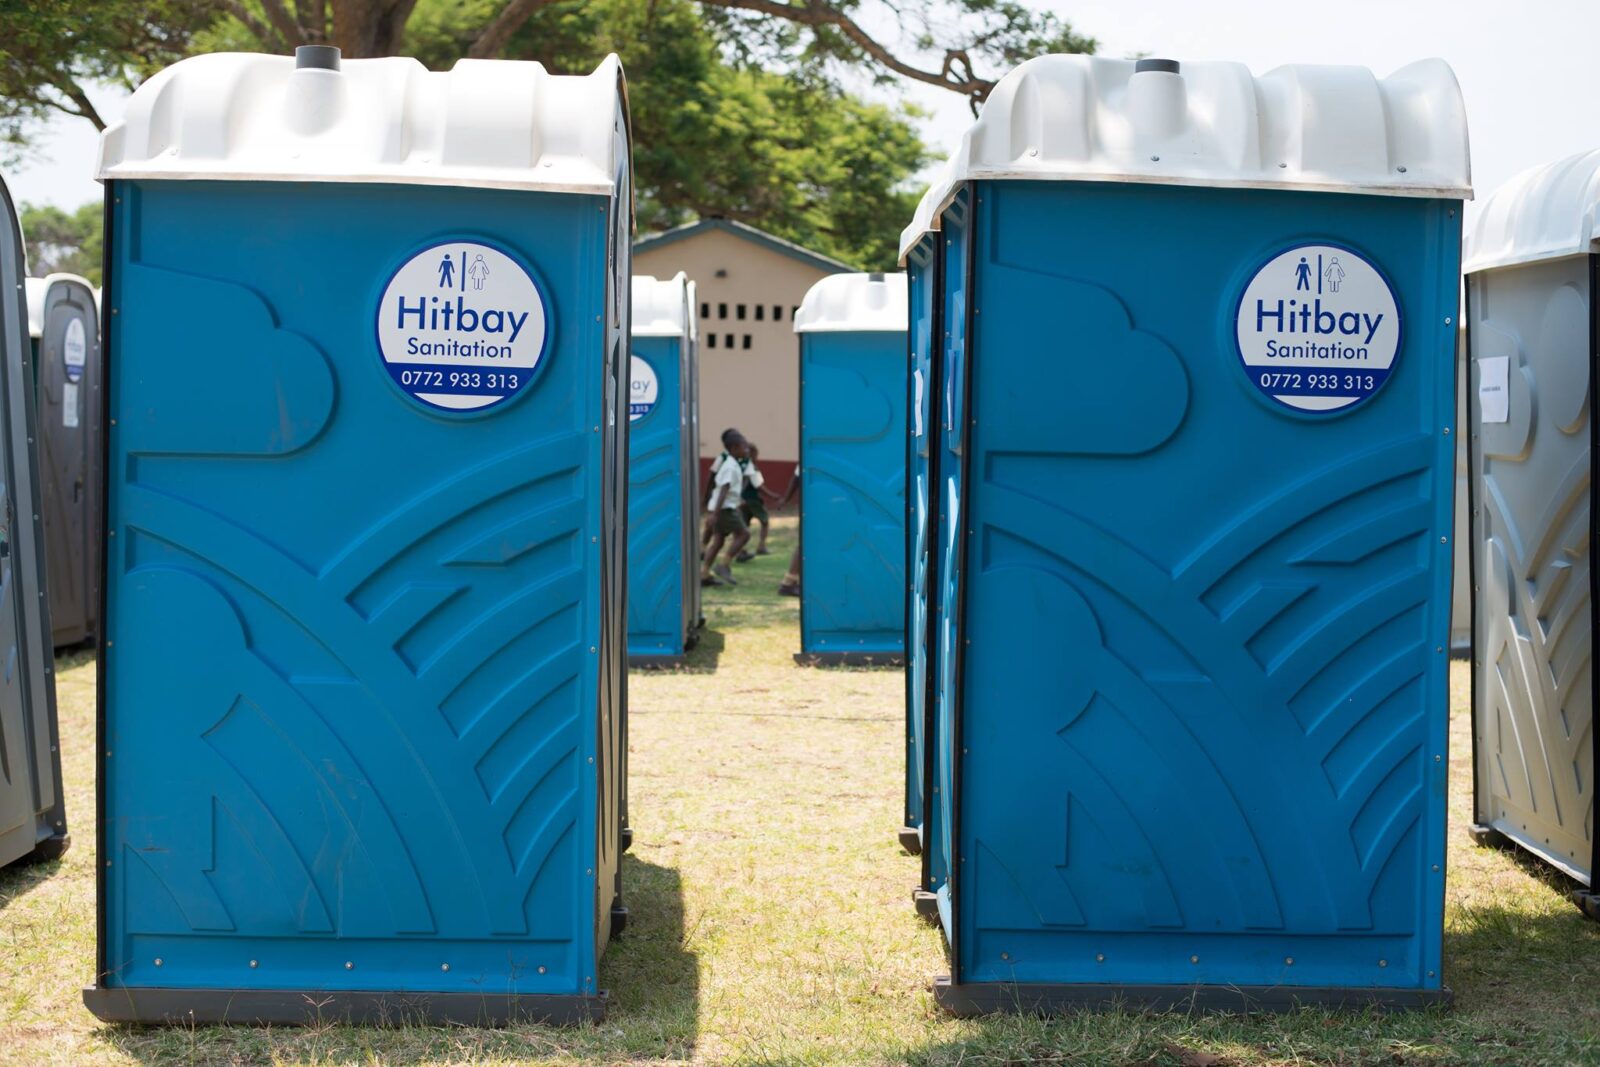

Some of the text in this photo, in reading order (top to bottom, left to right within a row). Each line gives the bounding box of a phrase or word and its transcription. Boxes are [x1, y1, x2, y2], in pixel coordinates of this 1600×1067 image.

[397, 296, 529, 343] Hitbay
[1256, 299, 1384, 345] Hitbay
[407, 337, 512, 359] Sanitation
[1266, 340, 1368, 360] Sanitation
[401, 370, 518, 389] 0772 933 313
[1260, 373, 1374, 390] 0772 933 313
